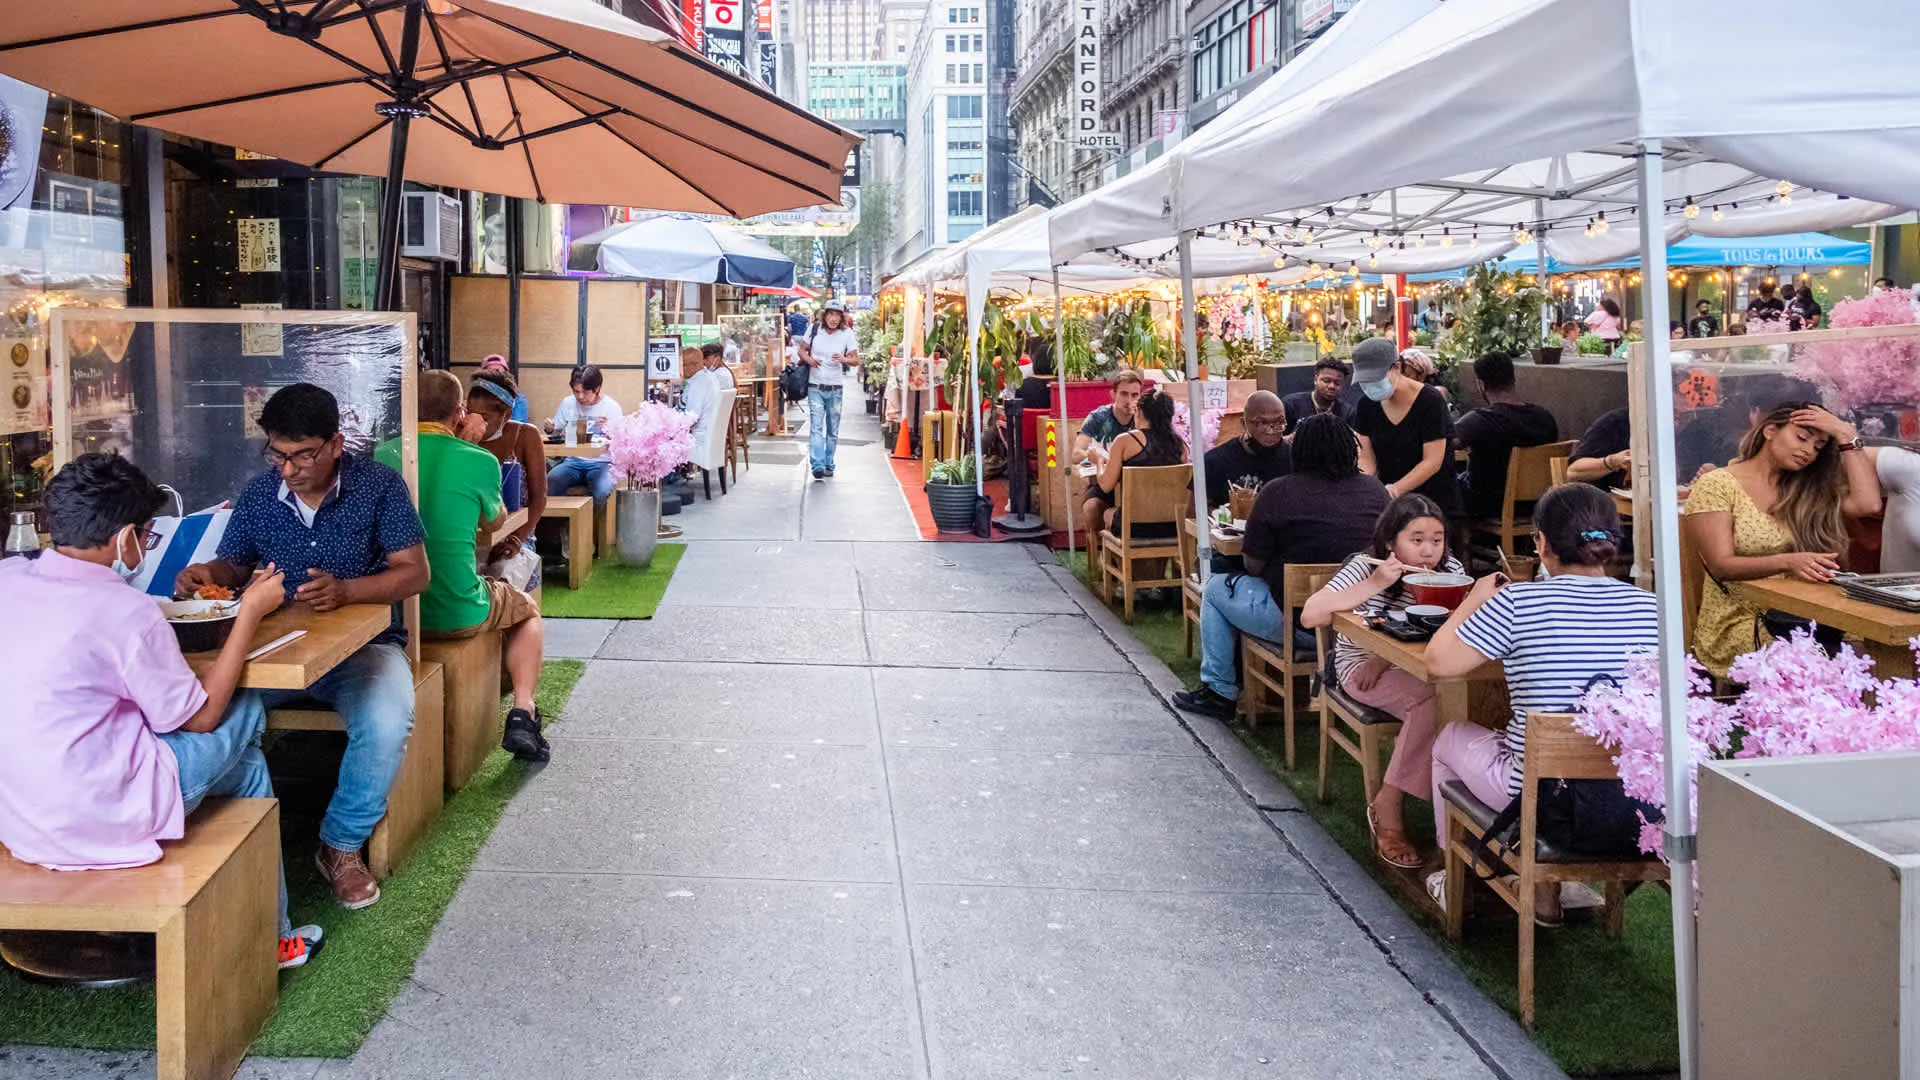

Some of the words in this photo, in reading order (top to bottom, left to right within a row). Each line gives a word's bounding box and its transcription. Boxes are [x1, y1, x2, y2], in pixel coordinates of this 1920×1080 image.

[1080, 0, 1096, 131] TANFORD
[1080, 136, 1120, 146] HOTEL
[1720, 247, 1761, 262] TOUS
[1779, 247, 1825, 263] JOURS
